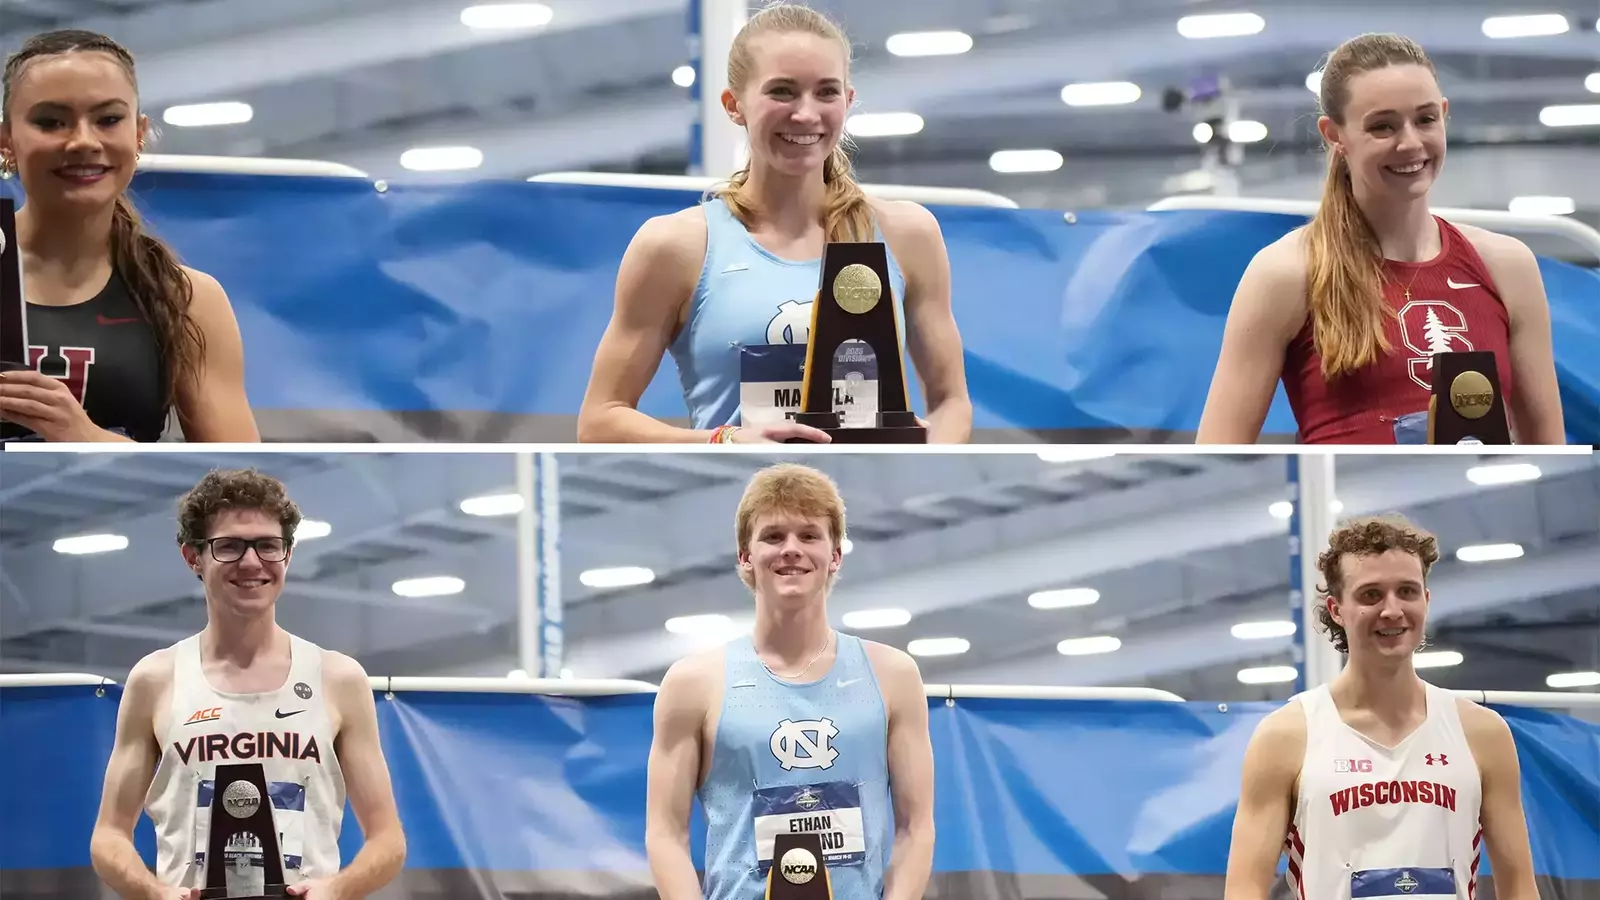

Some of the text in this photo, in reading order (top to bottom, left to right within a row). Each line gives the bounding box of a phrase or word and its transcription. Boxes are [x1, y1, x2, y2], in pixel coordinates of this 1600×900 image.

[187, 707, 222, 721] ACC
[173, 731, 321, 766] VIRGINIA
[1329, 780, 1456, 817] WISCONSIN
[789, 815, 831, 833] ETHAN
[784, 864, 814, 874] NCAA
